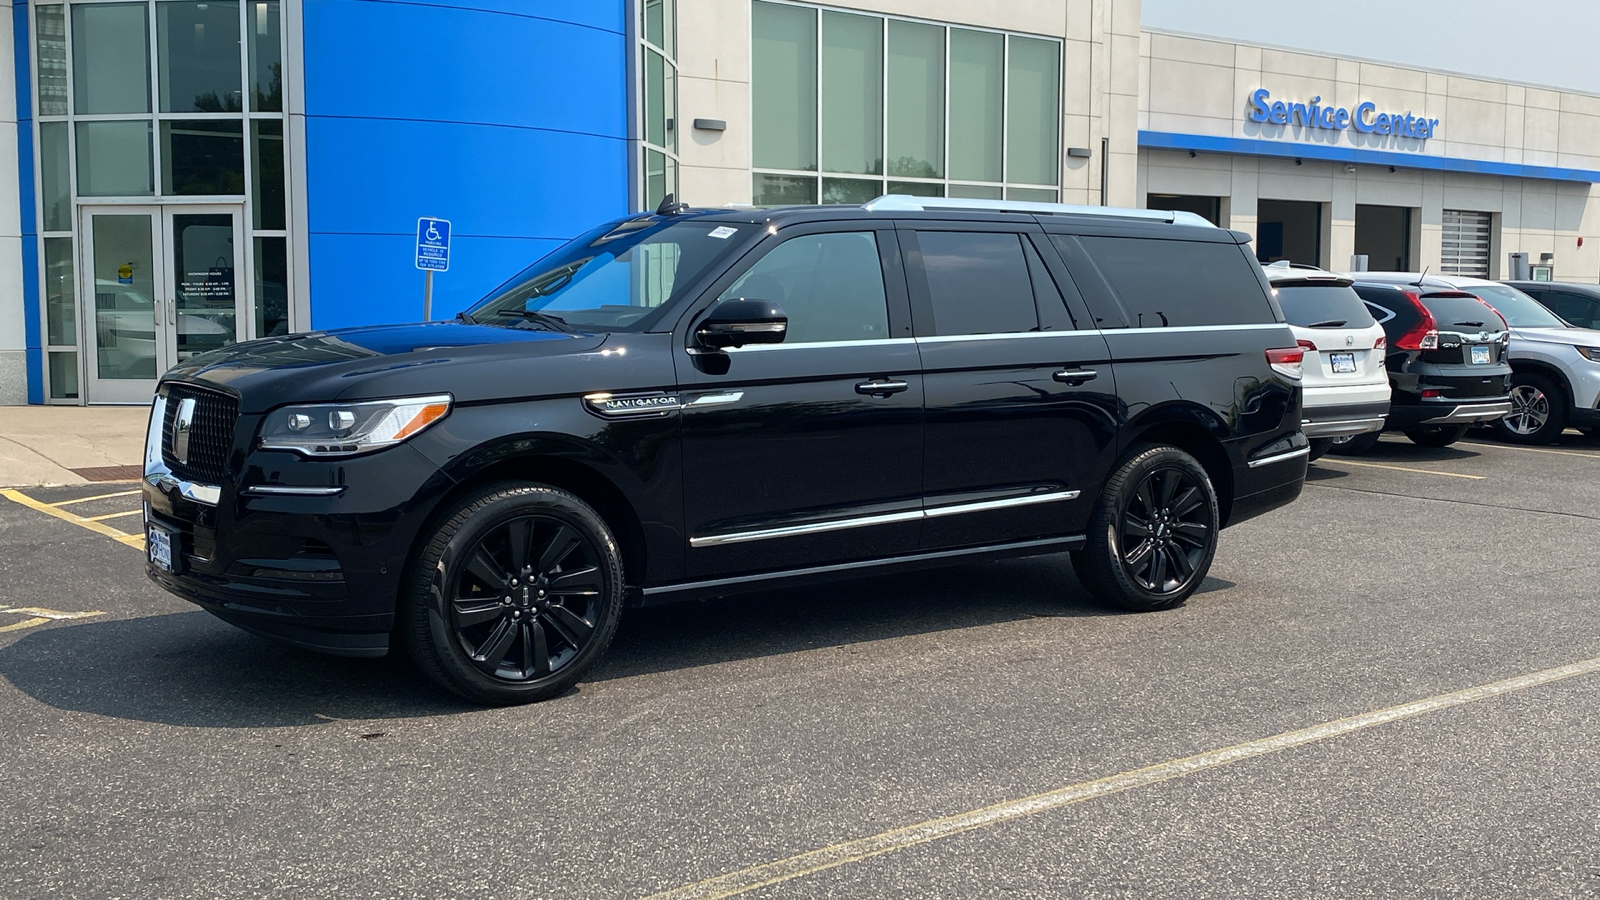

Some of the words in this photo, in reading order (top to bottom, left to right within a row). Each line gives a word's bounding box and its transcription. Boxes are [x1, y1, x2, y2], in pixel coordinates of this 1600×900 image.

[1251, 88, 1349, 130] Service
[1353, 101, 1439, 138] Center
[606, 397, 677, 408] NAVIGATOR
[604, 545, 619, 617] SCORPION
